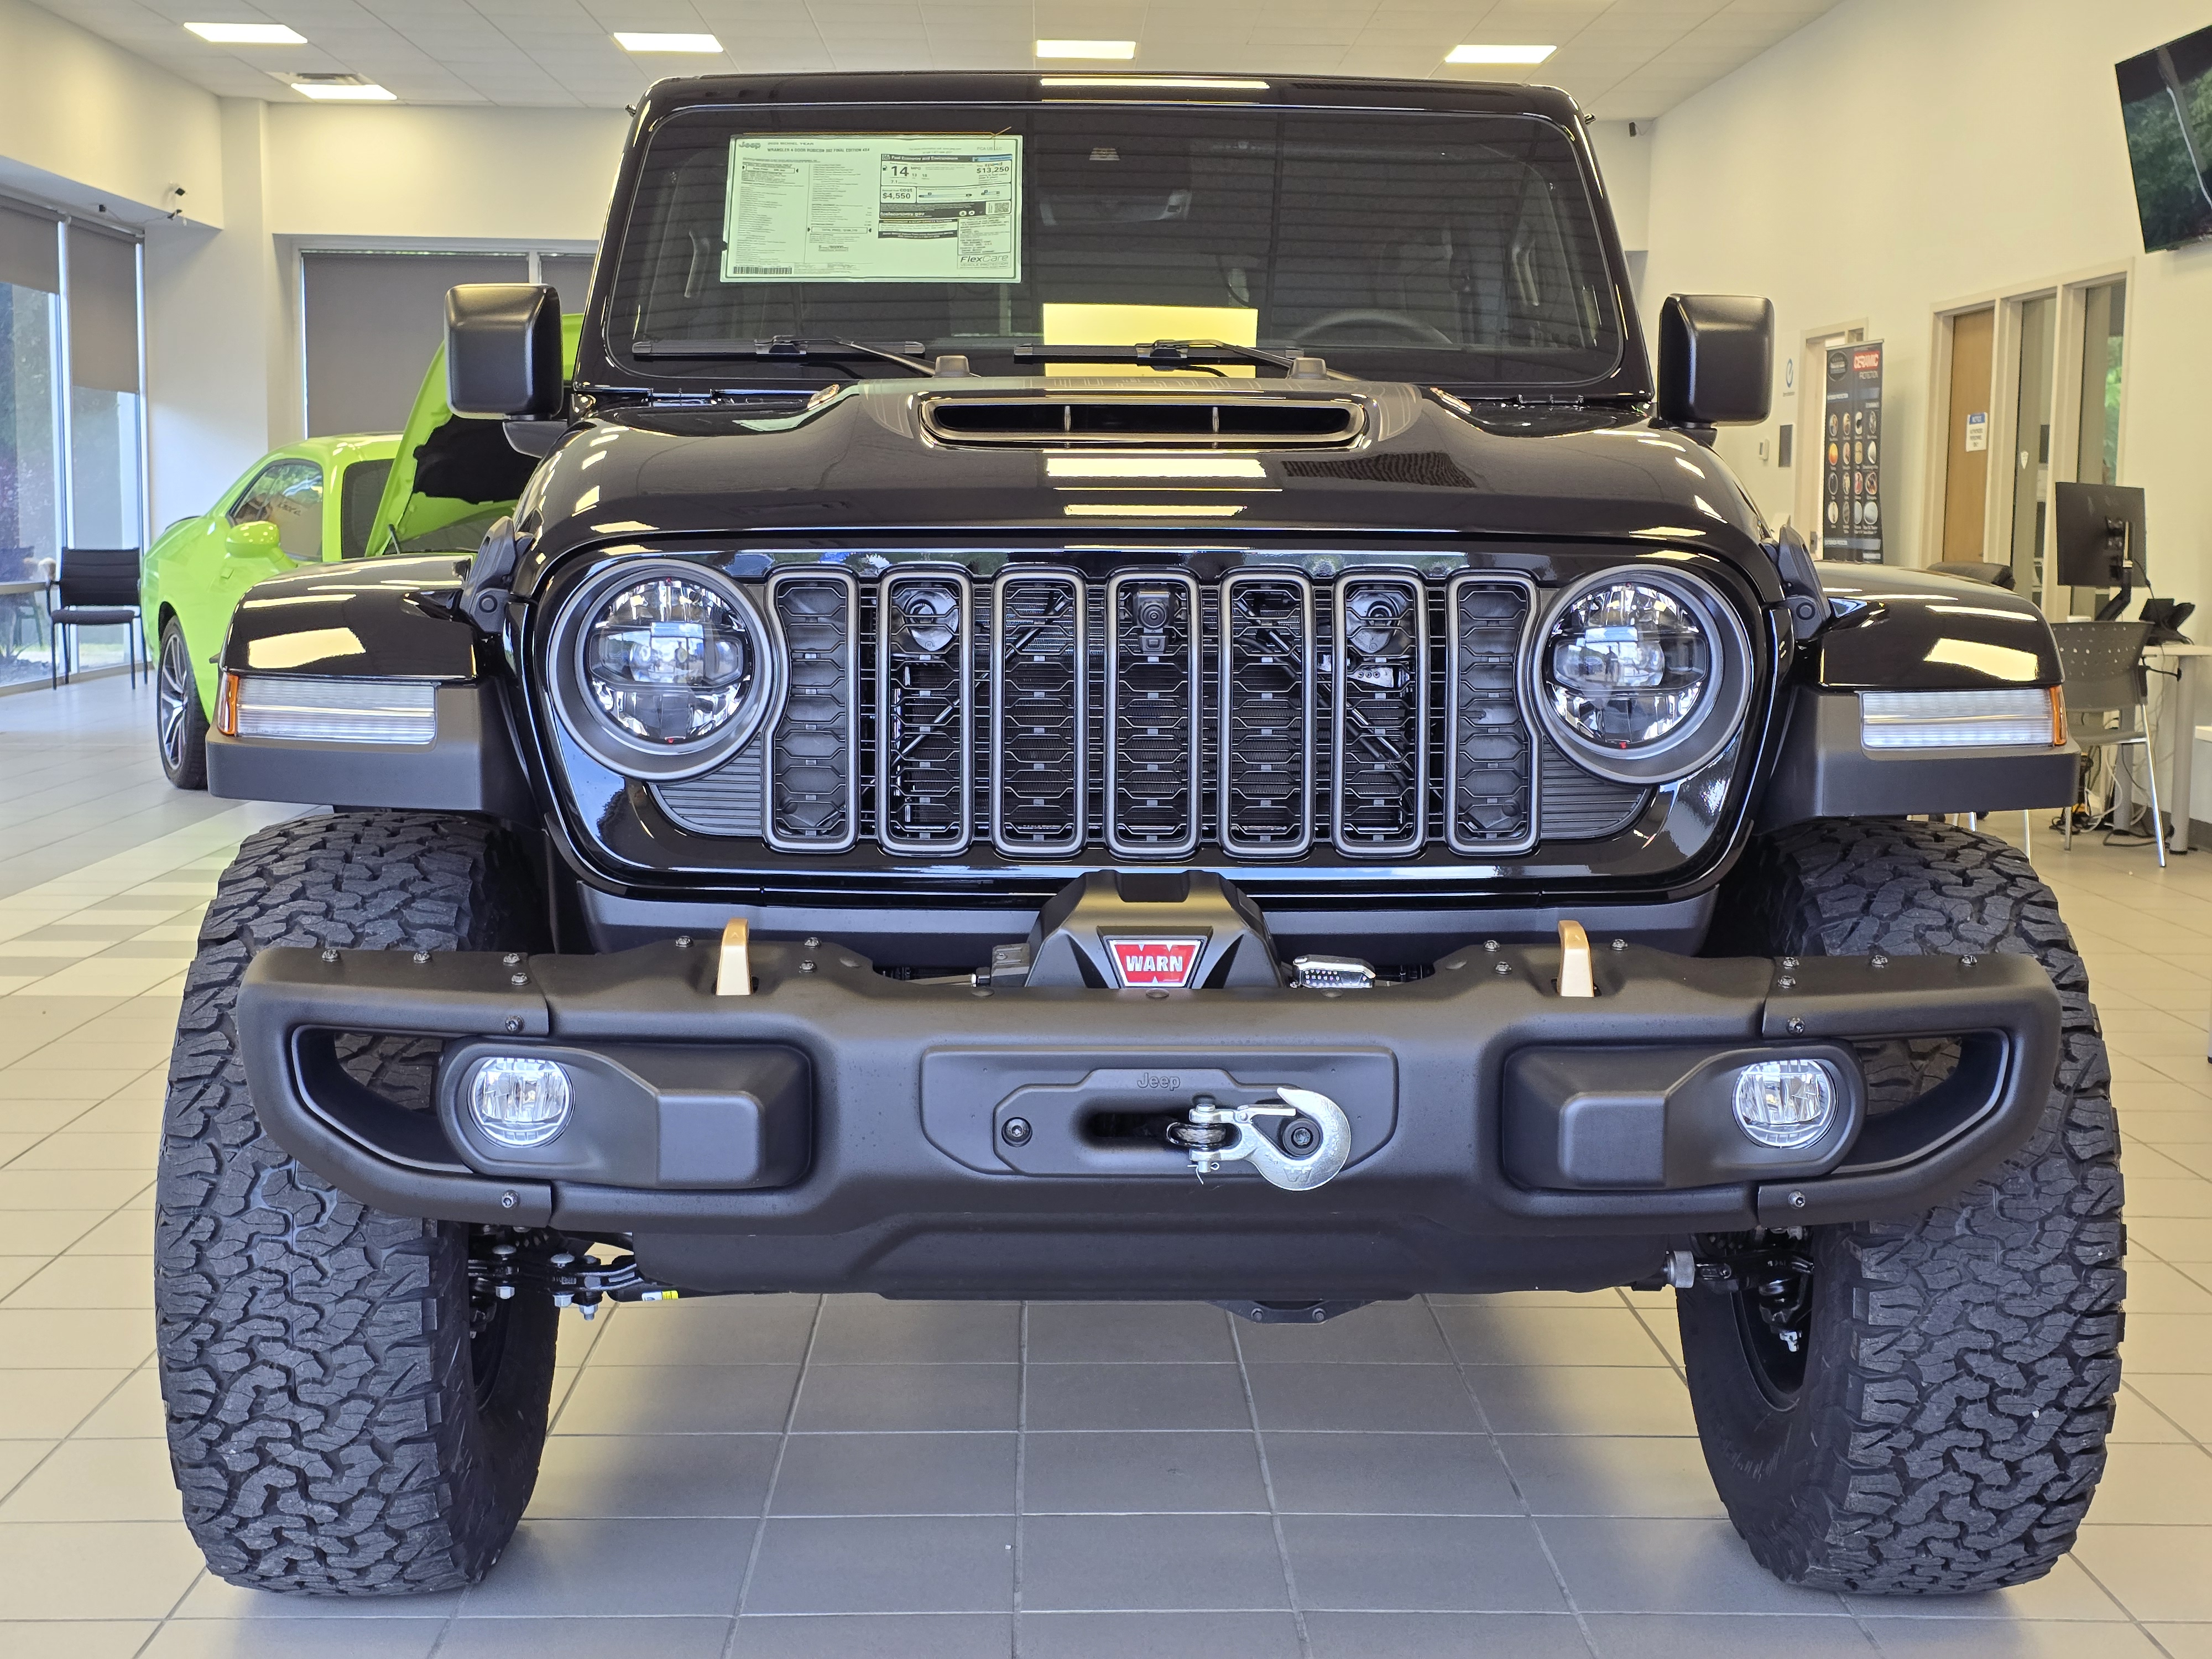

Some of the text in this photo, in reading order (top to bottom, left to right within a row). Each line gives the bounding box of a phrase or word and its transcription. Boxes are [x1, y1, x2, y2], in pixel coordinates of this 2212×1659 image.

[891, 165, 910, 176] 14
[1125, 955, 1183, 972] WARN
[1136, 1072, 1181, 1092] Jeep
